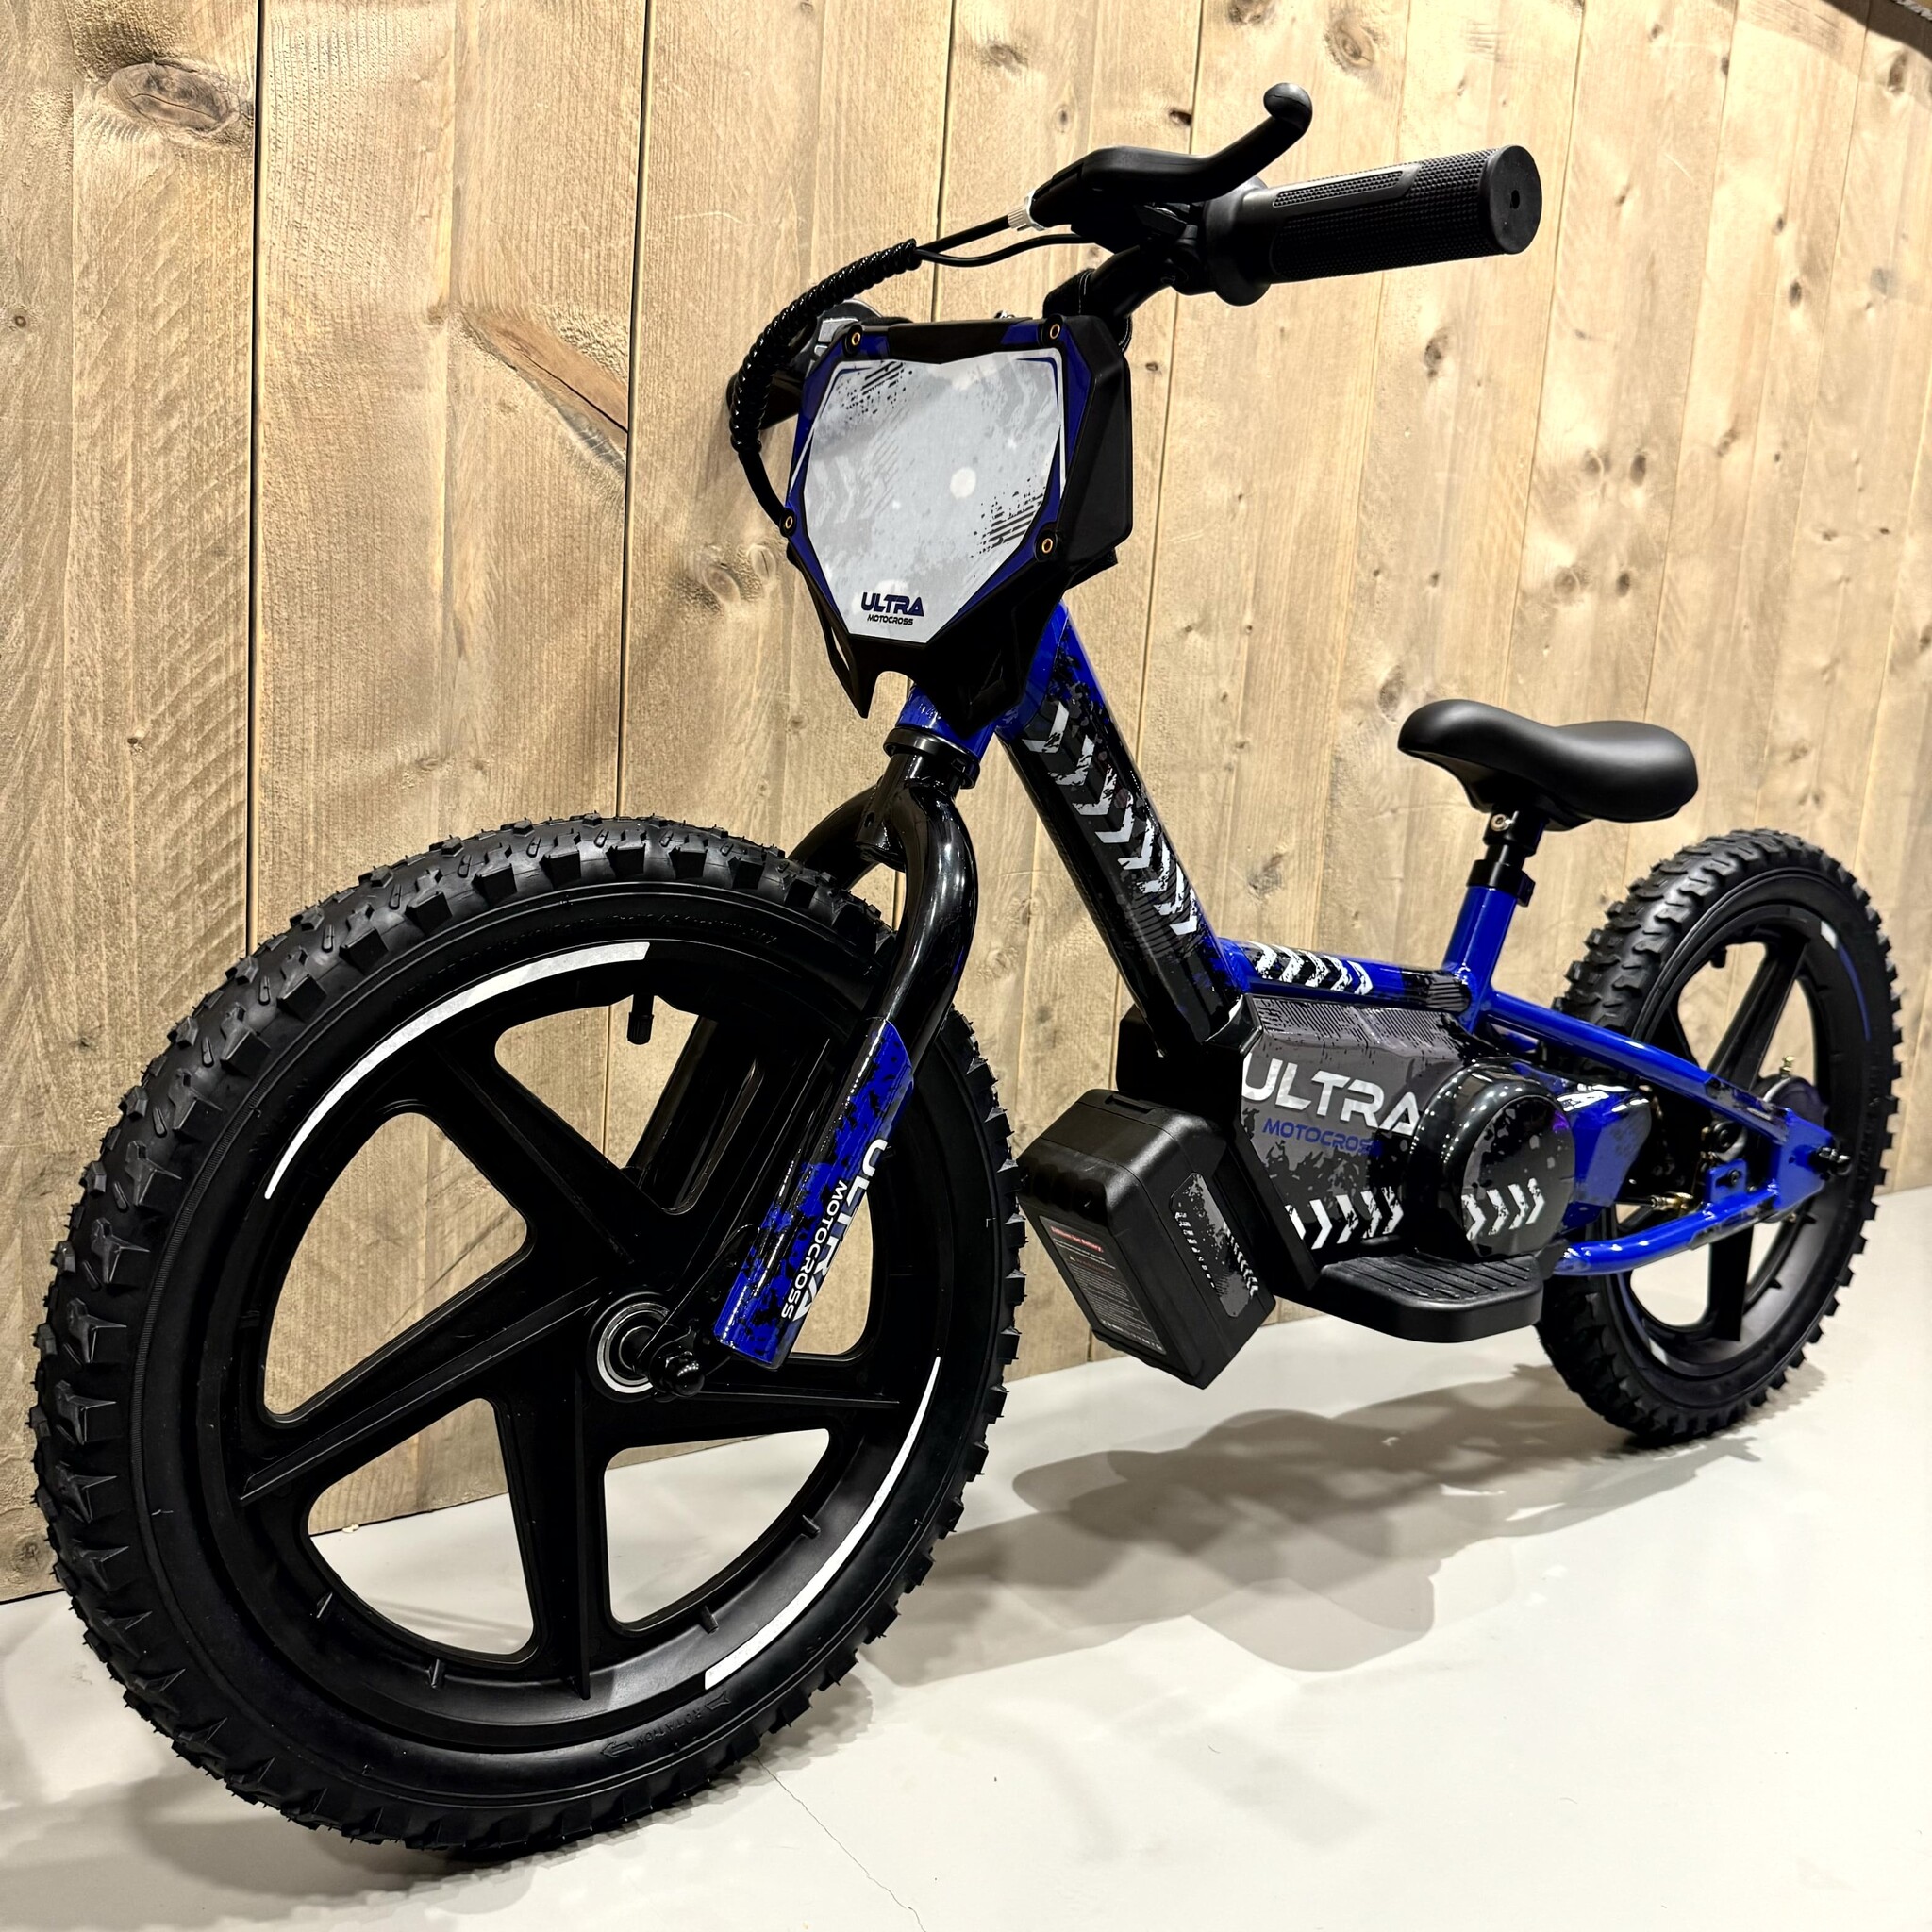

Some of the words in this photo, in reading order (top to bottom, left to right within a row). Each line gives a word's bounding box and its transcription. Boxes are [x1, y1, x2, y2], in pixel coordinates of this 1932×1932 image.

[861, 591, 924, 617] ULTRA
[867, 614, 914, 625] MOTOCROSS
[1241, 1052, 1421, 1136] ULTRA
[1261, 1117, 1384, 1157] MOTOCROS
[781, 1179, 848, 1319] MOTOCROSS
